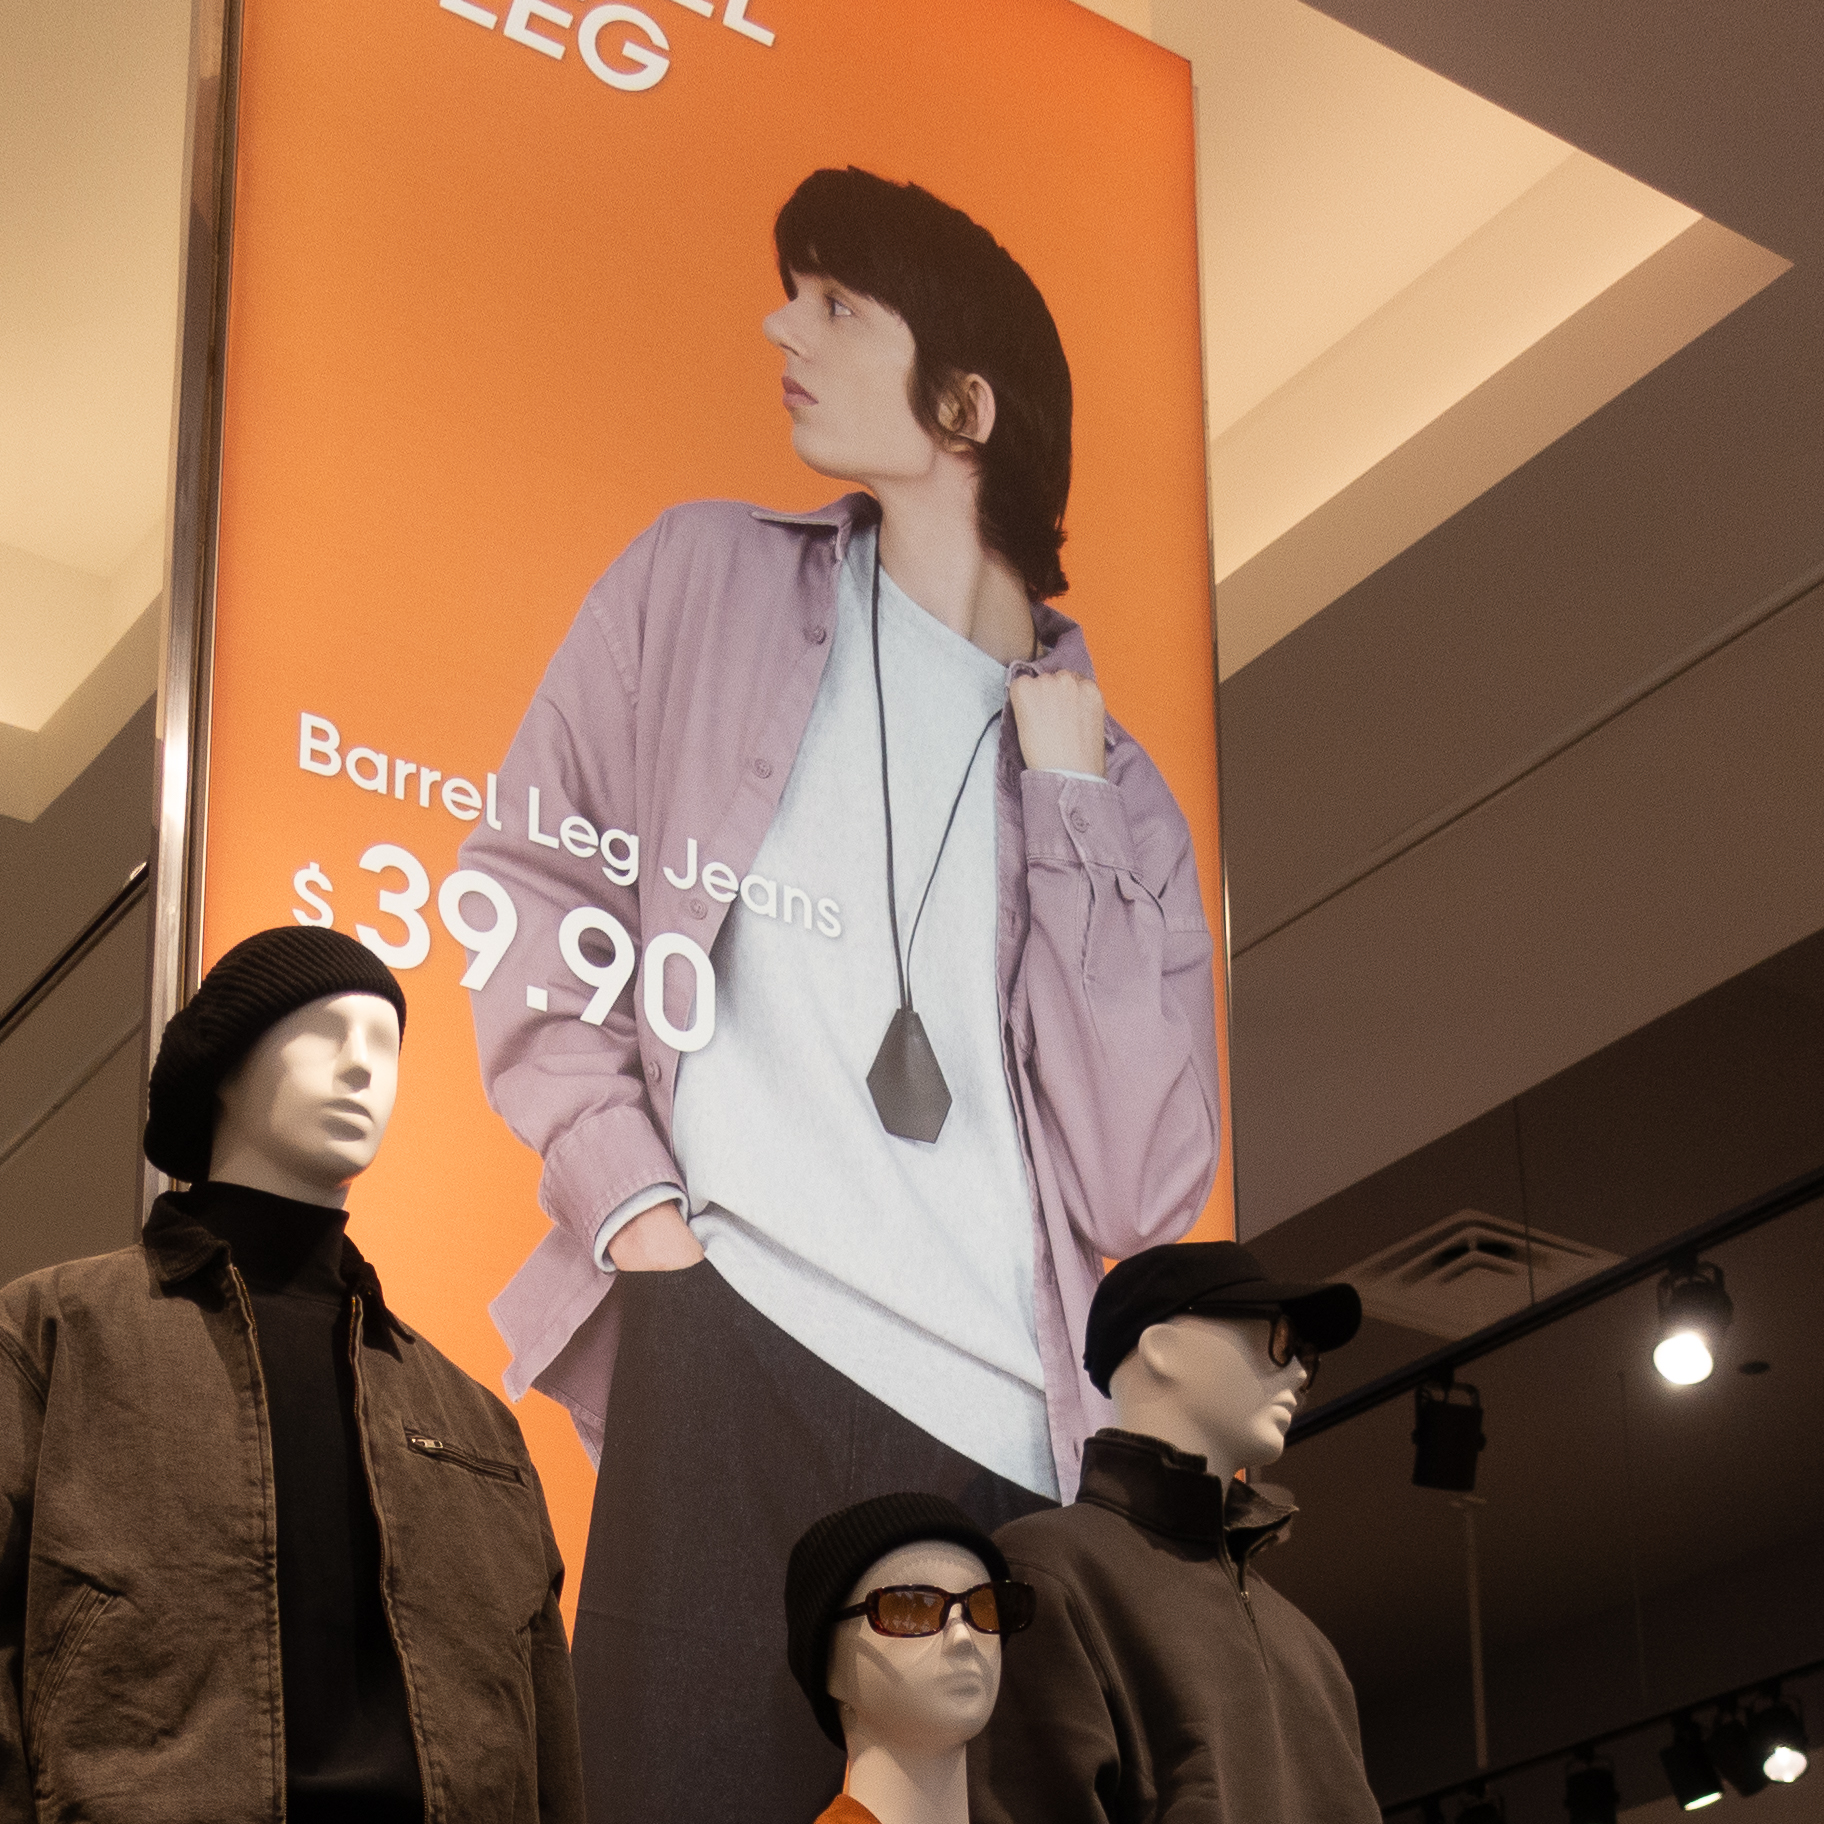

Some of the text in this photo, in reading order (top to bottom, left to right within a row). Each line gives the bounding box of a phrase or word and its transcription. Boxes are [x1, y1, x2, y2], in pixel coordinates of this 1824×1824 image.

[298, 711, 843, 938] Barrel Leg Jeans
